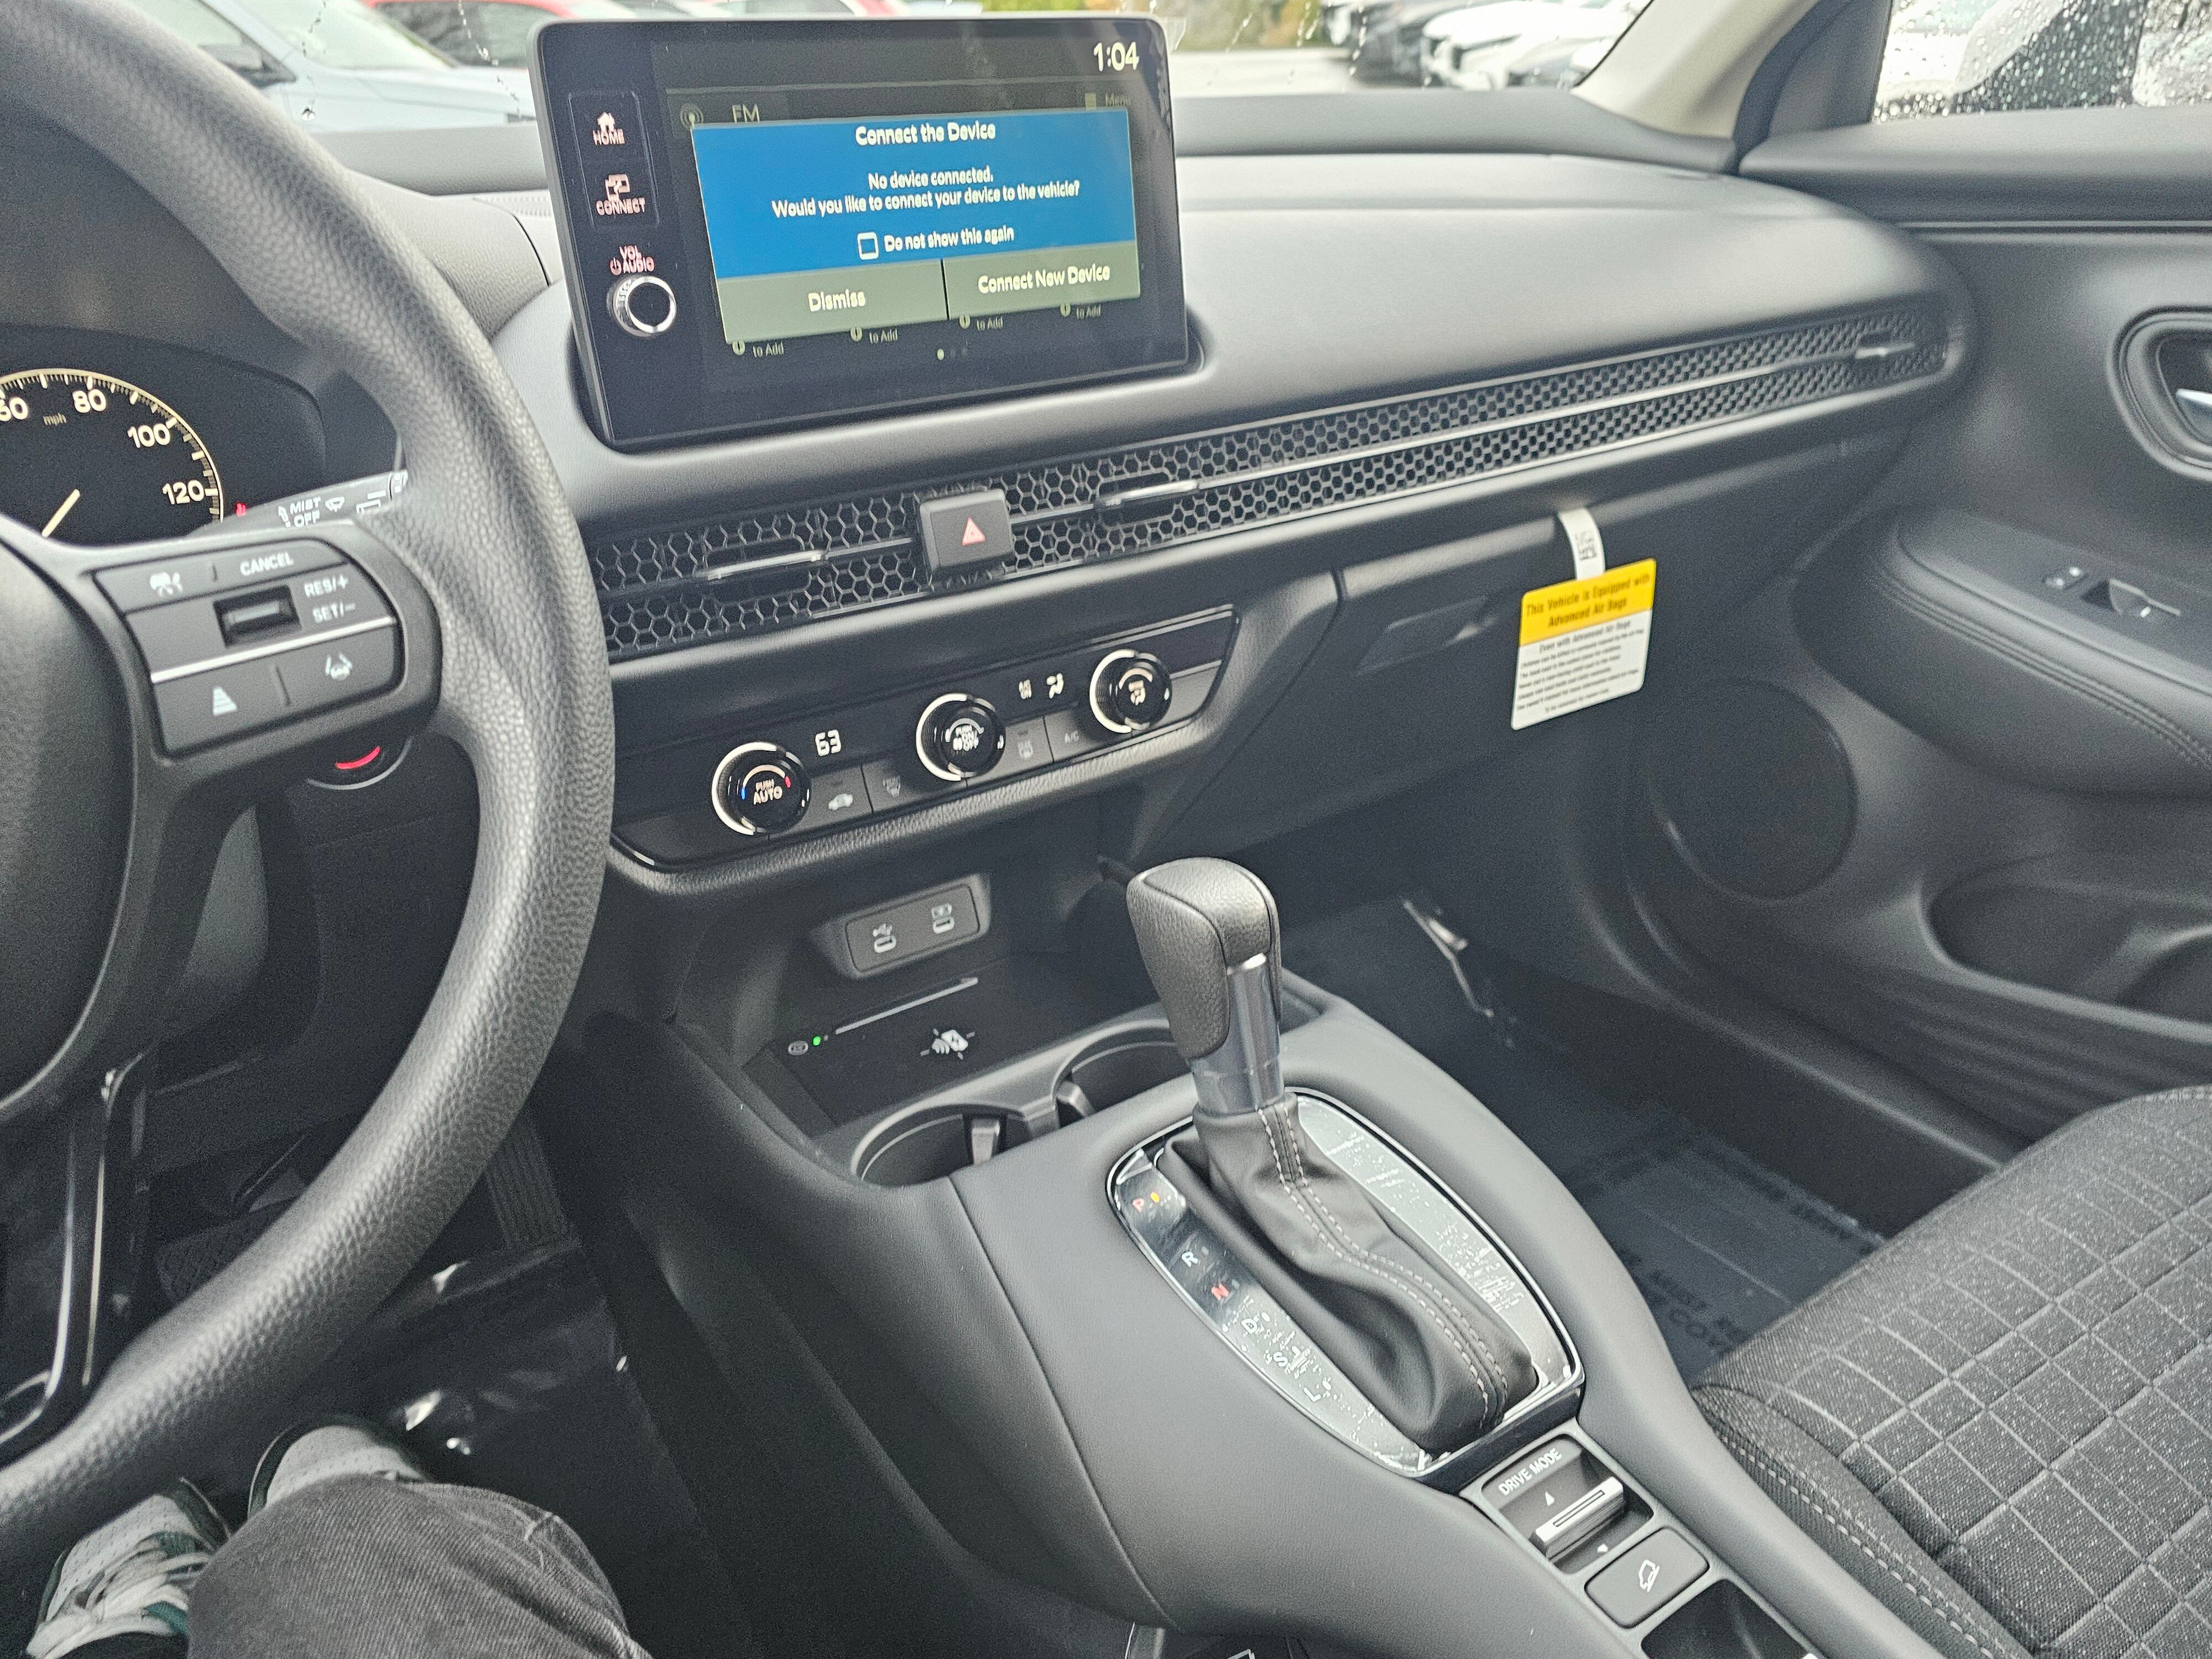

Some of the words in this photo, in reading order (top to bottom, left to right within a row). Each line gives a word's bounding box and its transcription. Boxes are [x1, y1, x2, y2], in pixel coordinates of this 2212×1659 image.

[1093, 42, 1139, 71] 1:04
[732, 104, 760, 124] FM
[593, 129, 625, 145] HOME
[855, 124, 917, 146] Connect
[920, 123, 945, 142] the
[947, 121, 995, 142] Device
[868, 172, 886, 190] No
[889, 169, 928, 189] device
[931, 165, 994, 186] connected.
[596, 197, 645, 216] CONNECT
[771, 197, 815, 218] Would
[818, 199, 843, 218] you
[844, 194, 867, 213] like
[869, 195, 883, 211] to
[885, 190, 933, 209] connect
[935, 191, 962, 209] your
[964, 186, 1000, 205] device
[1002, 184, 1015, 201] to
[1017, 182, 1036, 200] the
[1037, 180, 1080, 199] vehicle?
[884, 235, 902, 252] Do
[904, 232, 926, 251] not
[927, 230, 958, 248] show
[961, 227, 982, 245] this
[984, 225, 1014, 244] again
[619, 245, 641, 260] VOL
[623, 257, 655, 274] AUDIO
[978, 270, 1033, 293] Connect
[1035, 268, 1066, 287] New
[1068, 265, 1110, 284] Device
[808, 289, 865, 312] Dismiss
[1085, 305, 1100, 317] Add
[987, 317, 1003, 330] Add
[880, 329, 898, 342] Add
[765, 342, 784, 356] Add
[72, 389, 106, 413] 80
[127, 423, 170, 448] 100
[163, 479, 205, 505] 120
[290, 497, 321, 514] MIST
[294, 510, 320, 527] OFF
[240, 553, 294, 576] CANCEL
[304, 575, 348, 598] RES/+
[1527, 602, 1544, 617] This
[1548, 593, 1579, 609] Vehicle
[1582, 589, 1589, 599] is
[1593, 578, 1631, 598] Equipped
[1635, 573, 1650, 586] with
[1548, 608, 1590, 628] Advanced
[1593, 602, 1604, 614] Air
[1608, 598, 1627, 612] Bags
[816, 729, 841, 757] 63
[1065, 730, 1079, 744] A/C
[754, 786, 782, 805] AUTO
[1132, 1198, 1145, 1213] P
[1181, 1250, 1199, 1268] R
[1211, 1283, 1230, 1301] N
[1241, 1318, 1258, 1334] D
[1273, 1352, 1288, 1367] S
[1303, 1386, 1321, 1402] L
[1499, 1467, 1532, 1496] DRIVE
[1529, 1448, 1562, 1474] MODE
